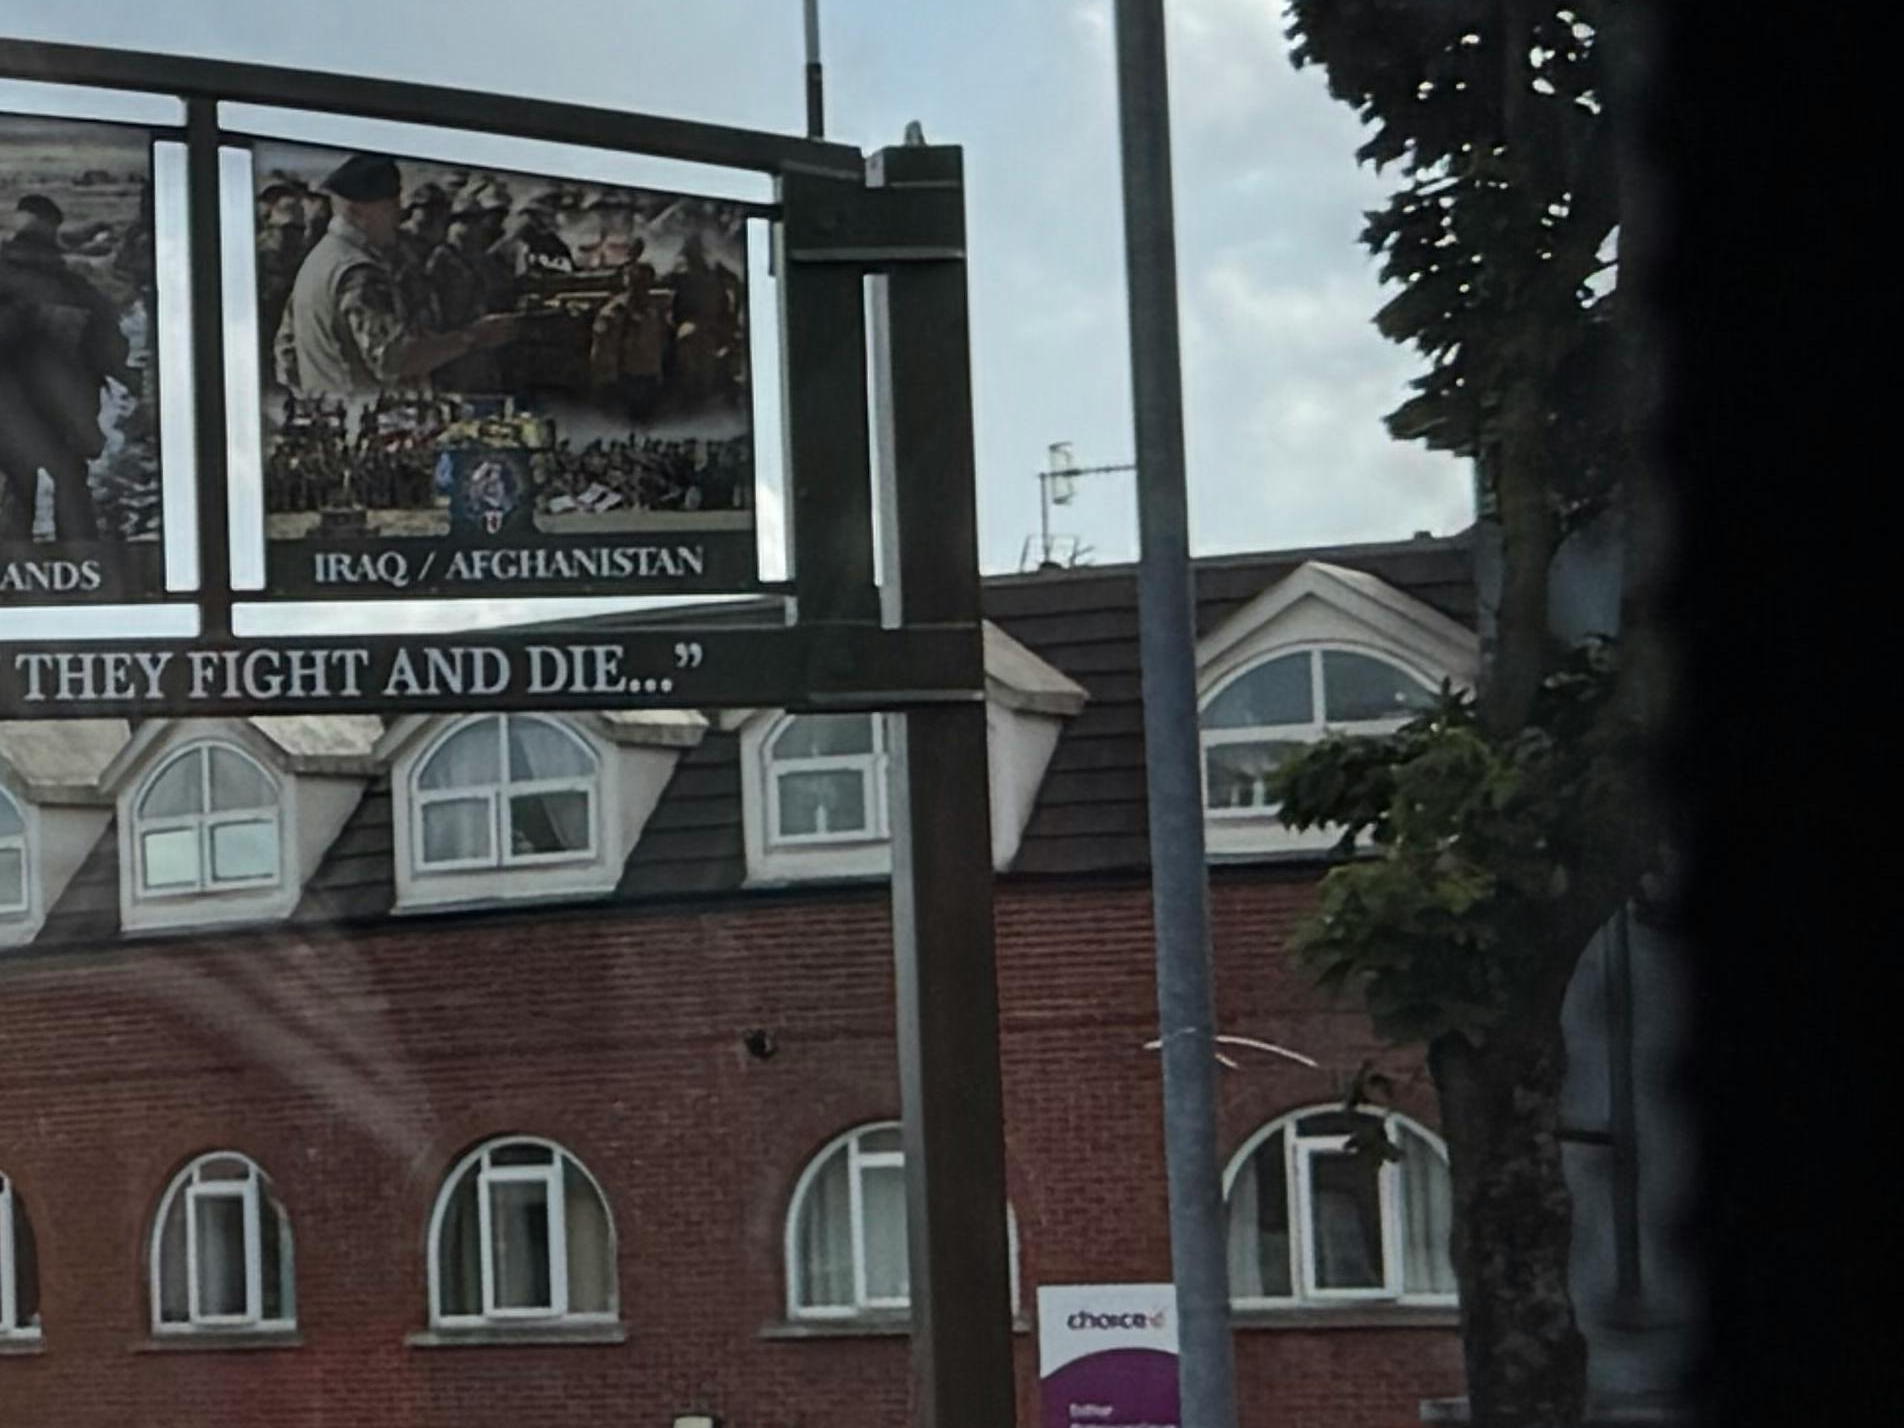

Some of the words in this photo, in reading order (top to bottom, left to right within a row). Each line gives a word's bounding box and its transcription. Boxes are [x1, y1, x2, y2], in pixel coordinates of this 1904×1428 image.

[314, 552, 409, 587] IRAQ
[445, 545, 704, 581] AFGHANISTAN
[15, 651, 178, 702] THEY
[187, 648, 369, 700] FIGHT
[382, 646, 511, 697] AND
[1067, 1310, 1148, 1331] choice
